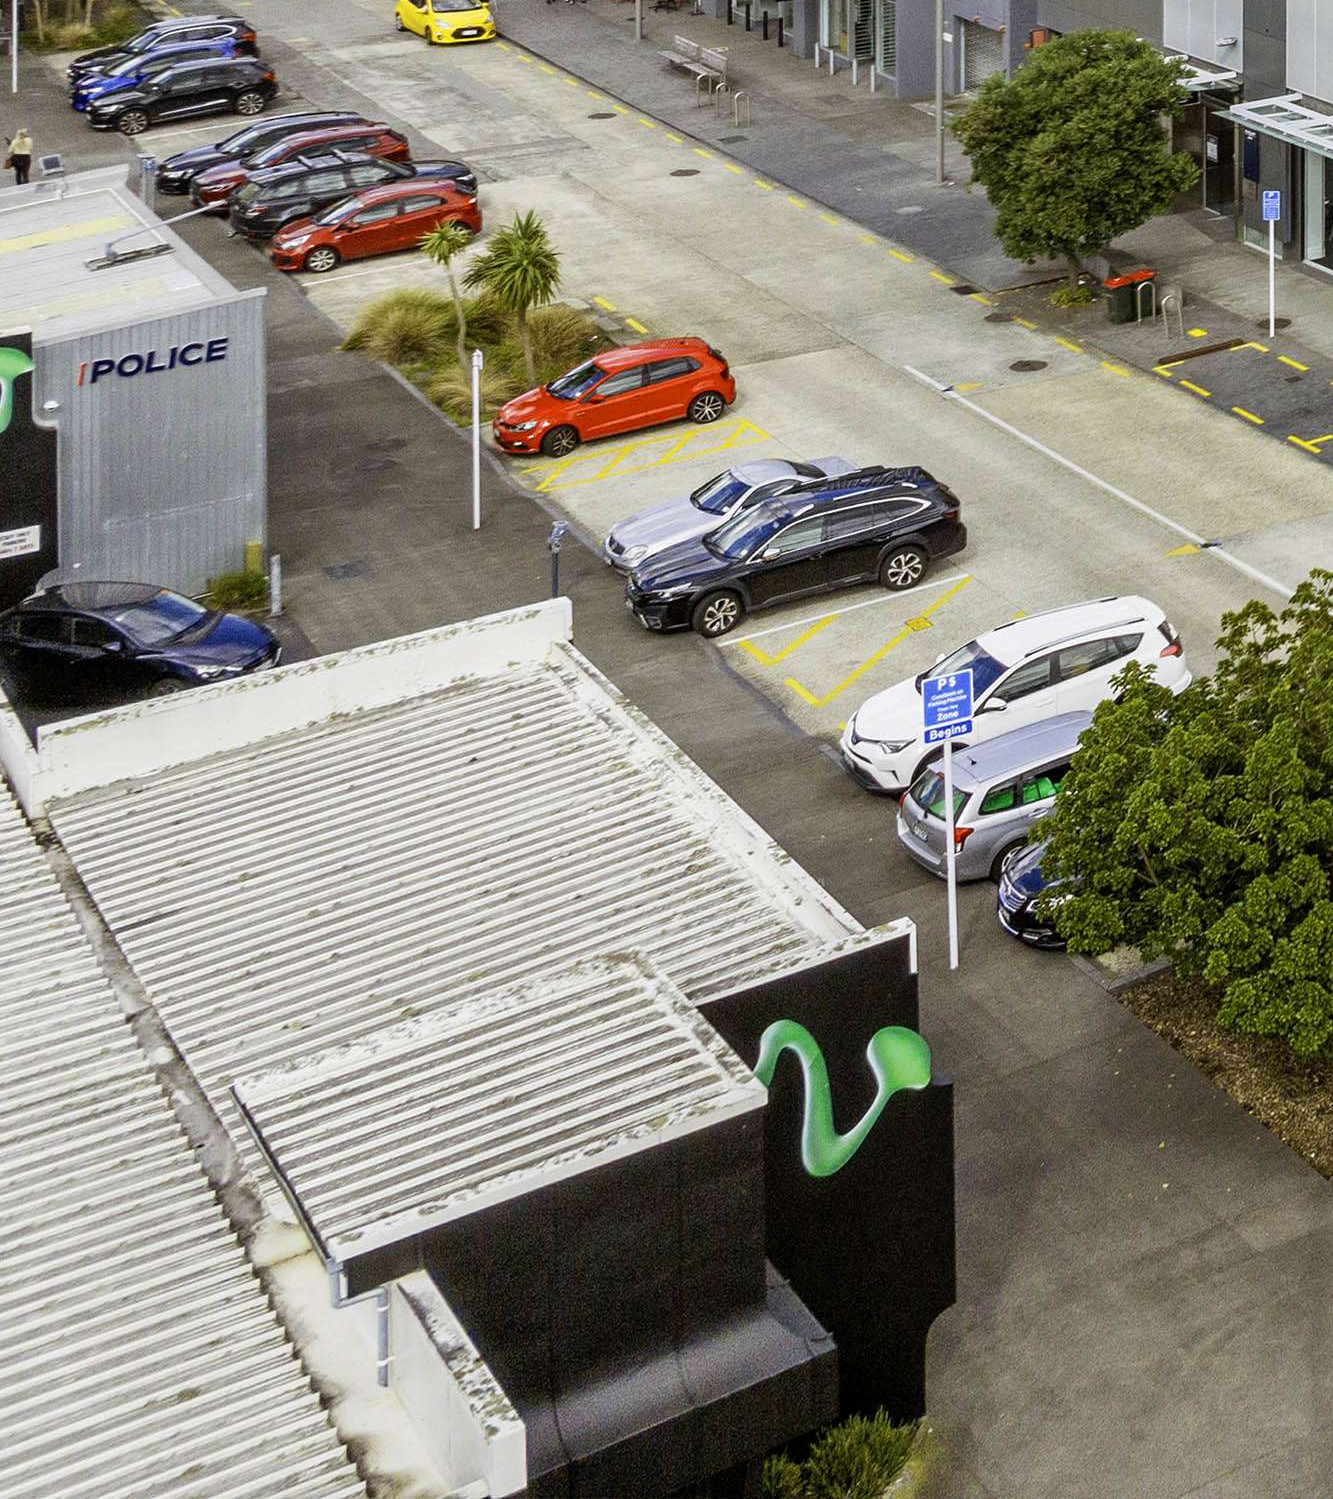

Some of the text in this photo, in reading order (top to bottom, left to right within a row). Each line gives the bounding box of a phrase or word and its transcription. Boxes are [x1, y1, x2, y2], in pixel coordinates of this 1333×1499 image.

[89, 336, 229, 384] POLICE
[936, 711, 959, 721] Zone
[929, 724, 967, 741] Begins
